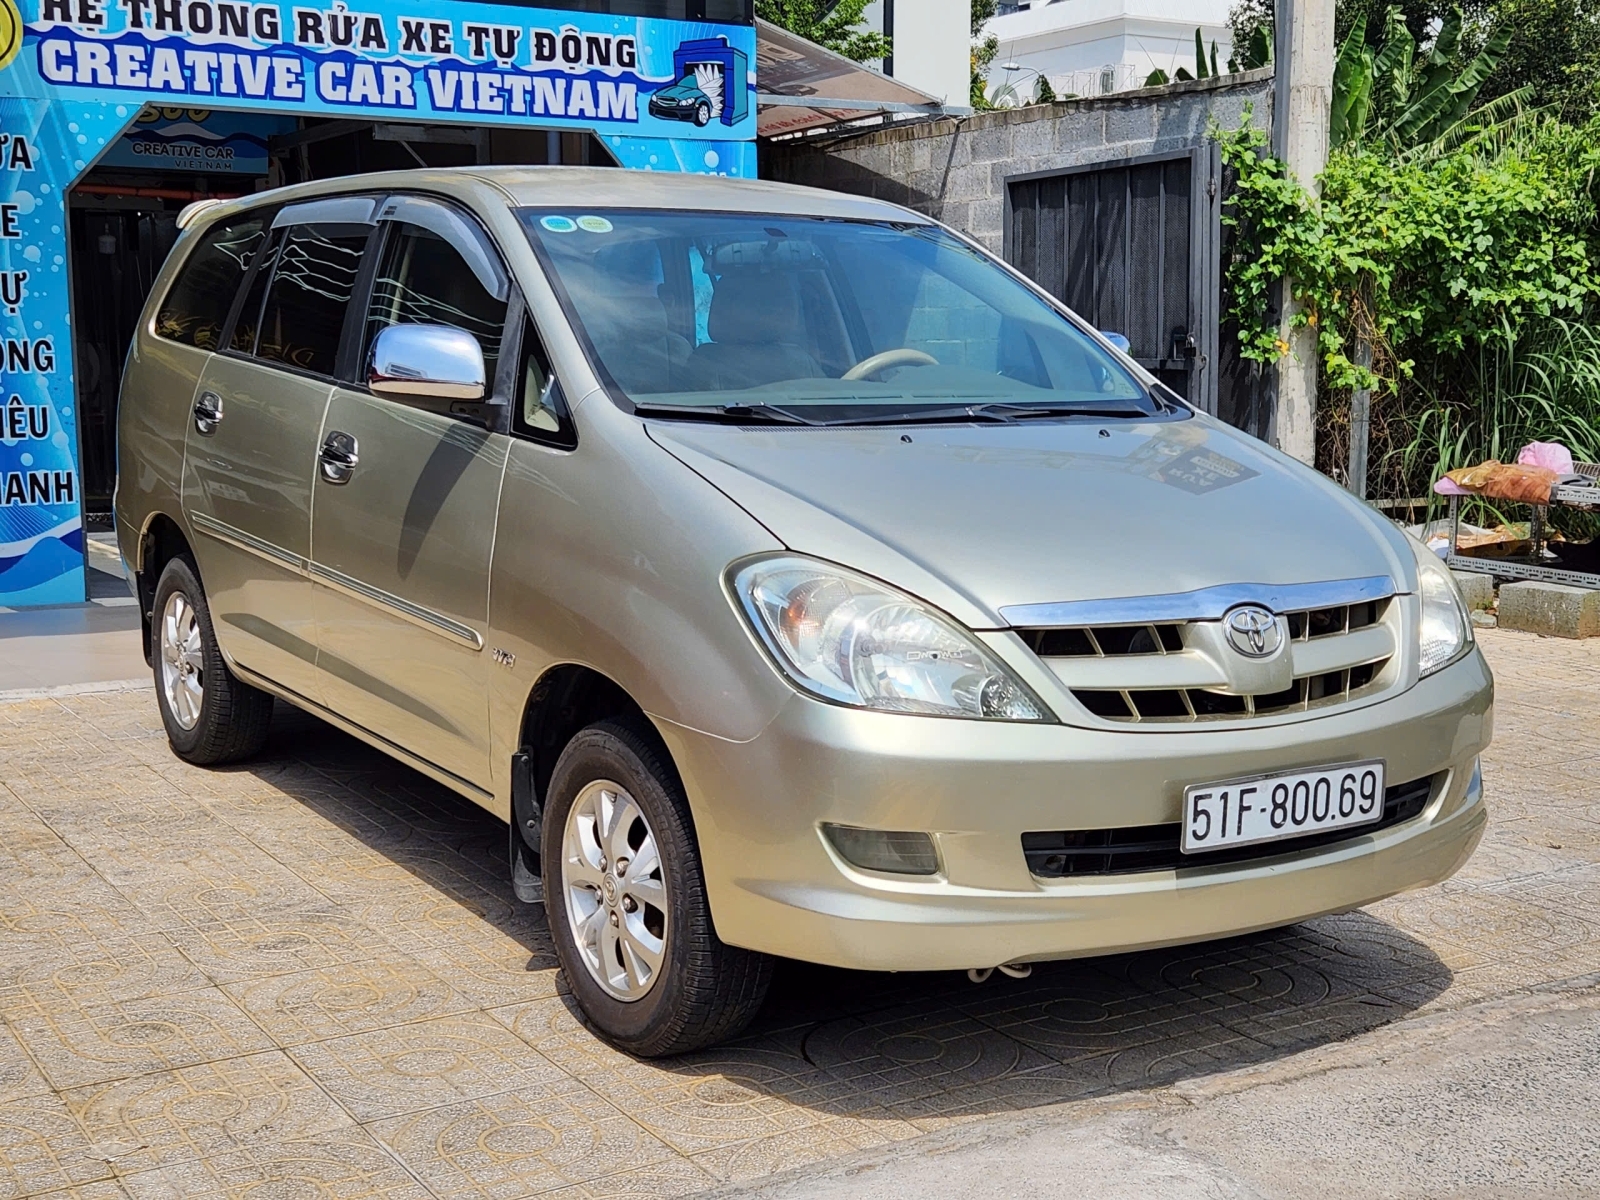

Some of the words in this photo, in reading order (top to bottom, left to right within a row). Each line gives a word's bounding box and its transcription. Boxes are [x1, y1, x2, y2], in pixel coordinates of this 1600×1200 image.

[298, 5, 386, 49] RỬA
[402, 20, 451, 54] XE
[467, 26, 520, 66] TỰ
[534, 29, 636, 70] ĐỘNG
[41, 39, 303, 98] CREATIVE
[320, 61, 414, 106] CAR
[426, 69, 638, 120] VIETNAM
[132, 142, 202, 158] CREATIVE
[205, 147, 234, 160] CAR
[174, 160, 233, 170] VIETNAM
[0, 340, 54, 372] NG
[1192, 770, 1376, 841] 51F-800.69
